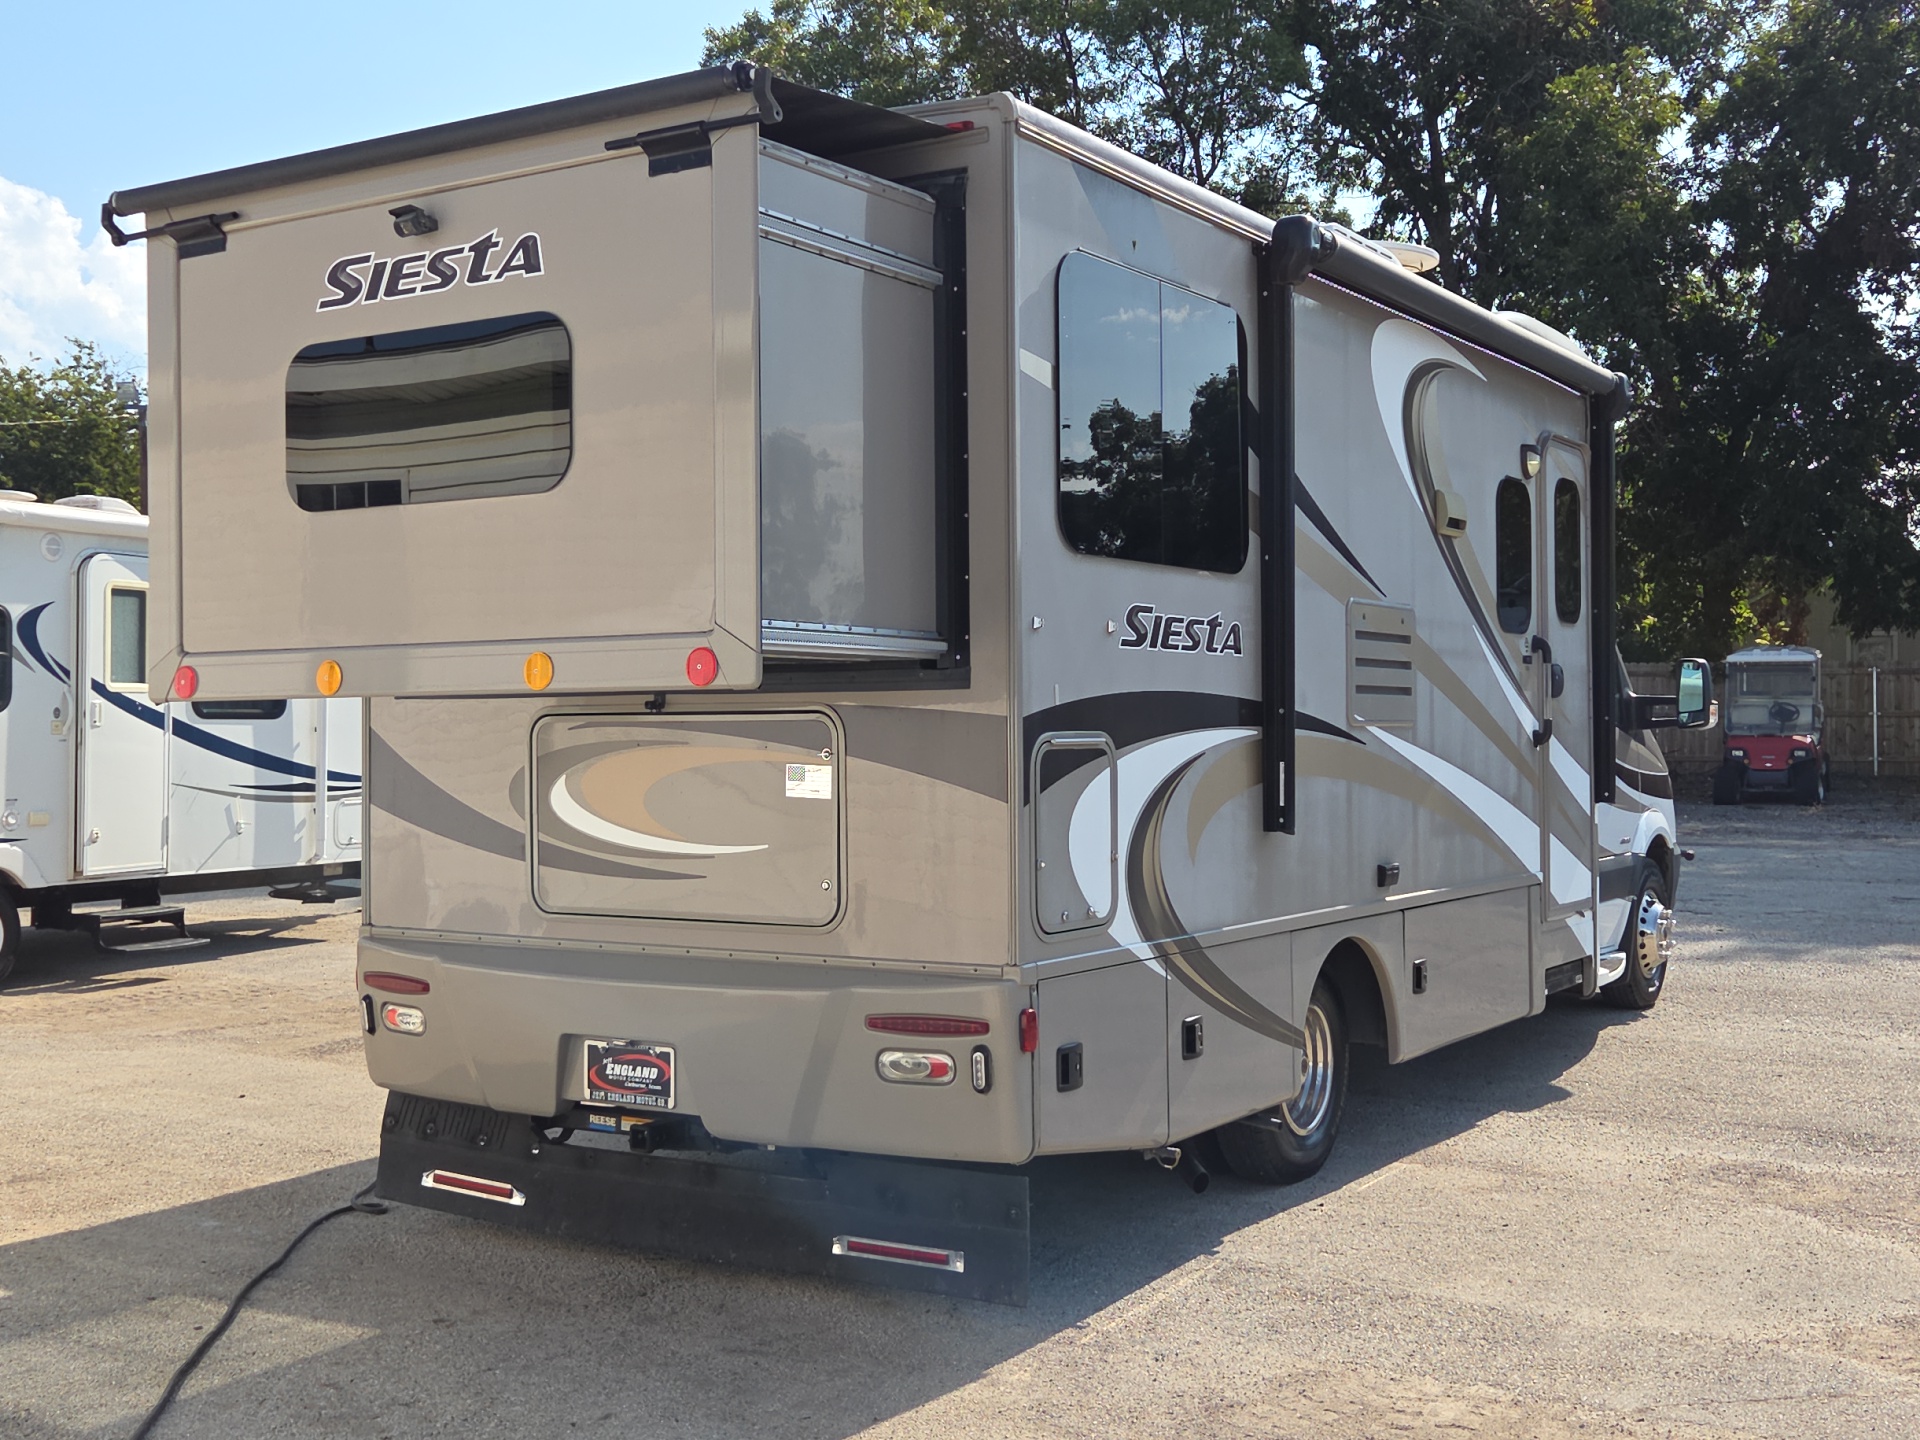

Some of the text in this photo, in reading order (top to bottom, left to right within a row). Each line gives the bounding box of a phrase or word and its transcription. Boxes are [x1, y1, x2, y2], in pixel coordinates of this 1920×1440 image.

[606, 1063, 658, 1079] ENGLAND
[608, 1092, 635, 1103] ENGLAND
[636, 1095, 656, 1105] MOTOR
[589, 1114, 616, 1126] REESE
